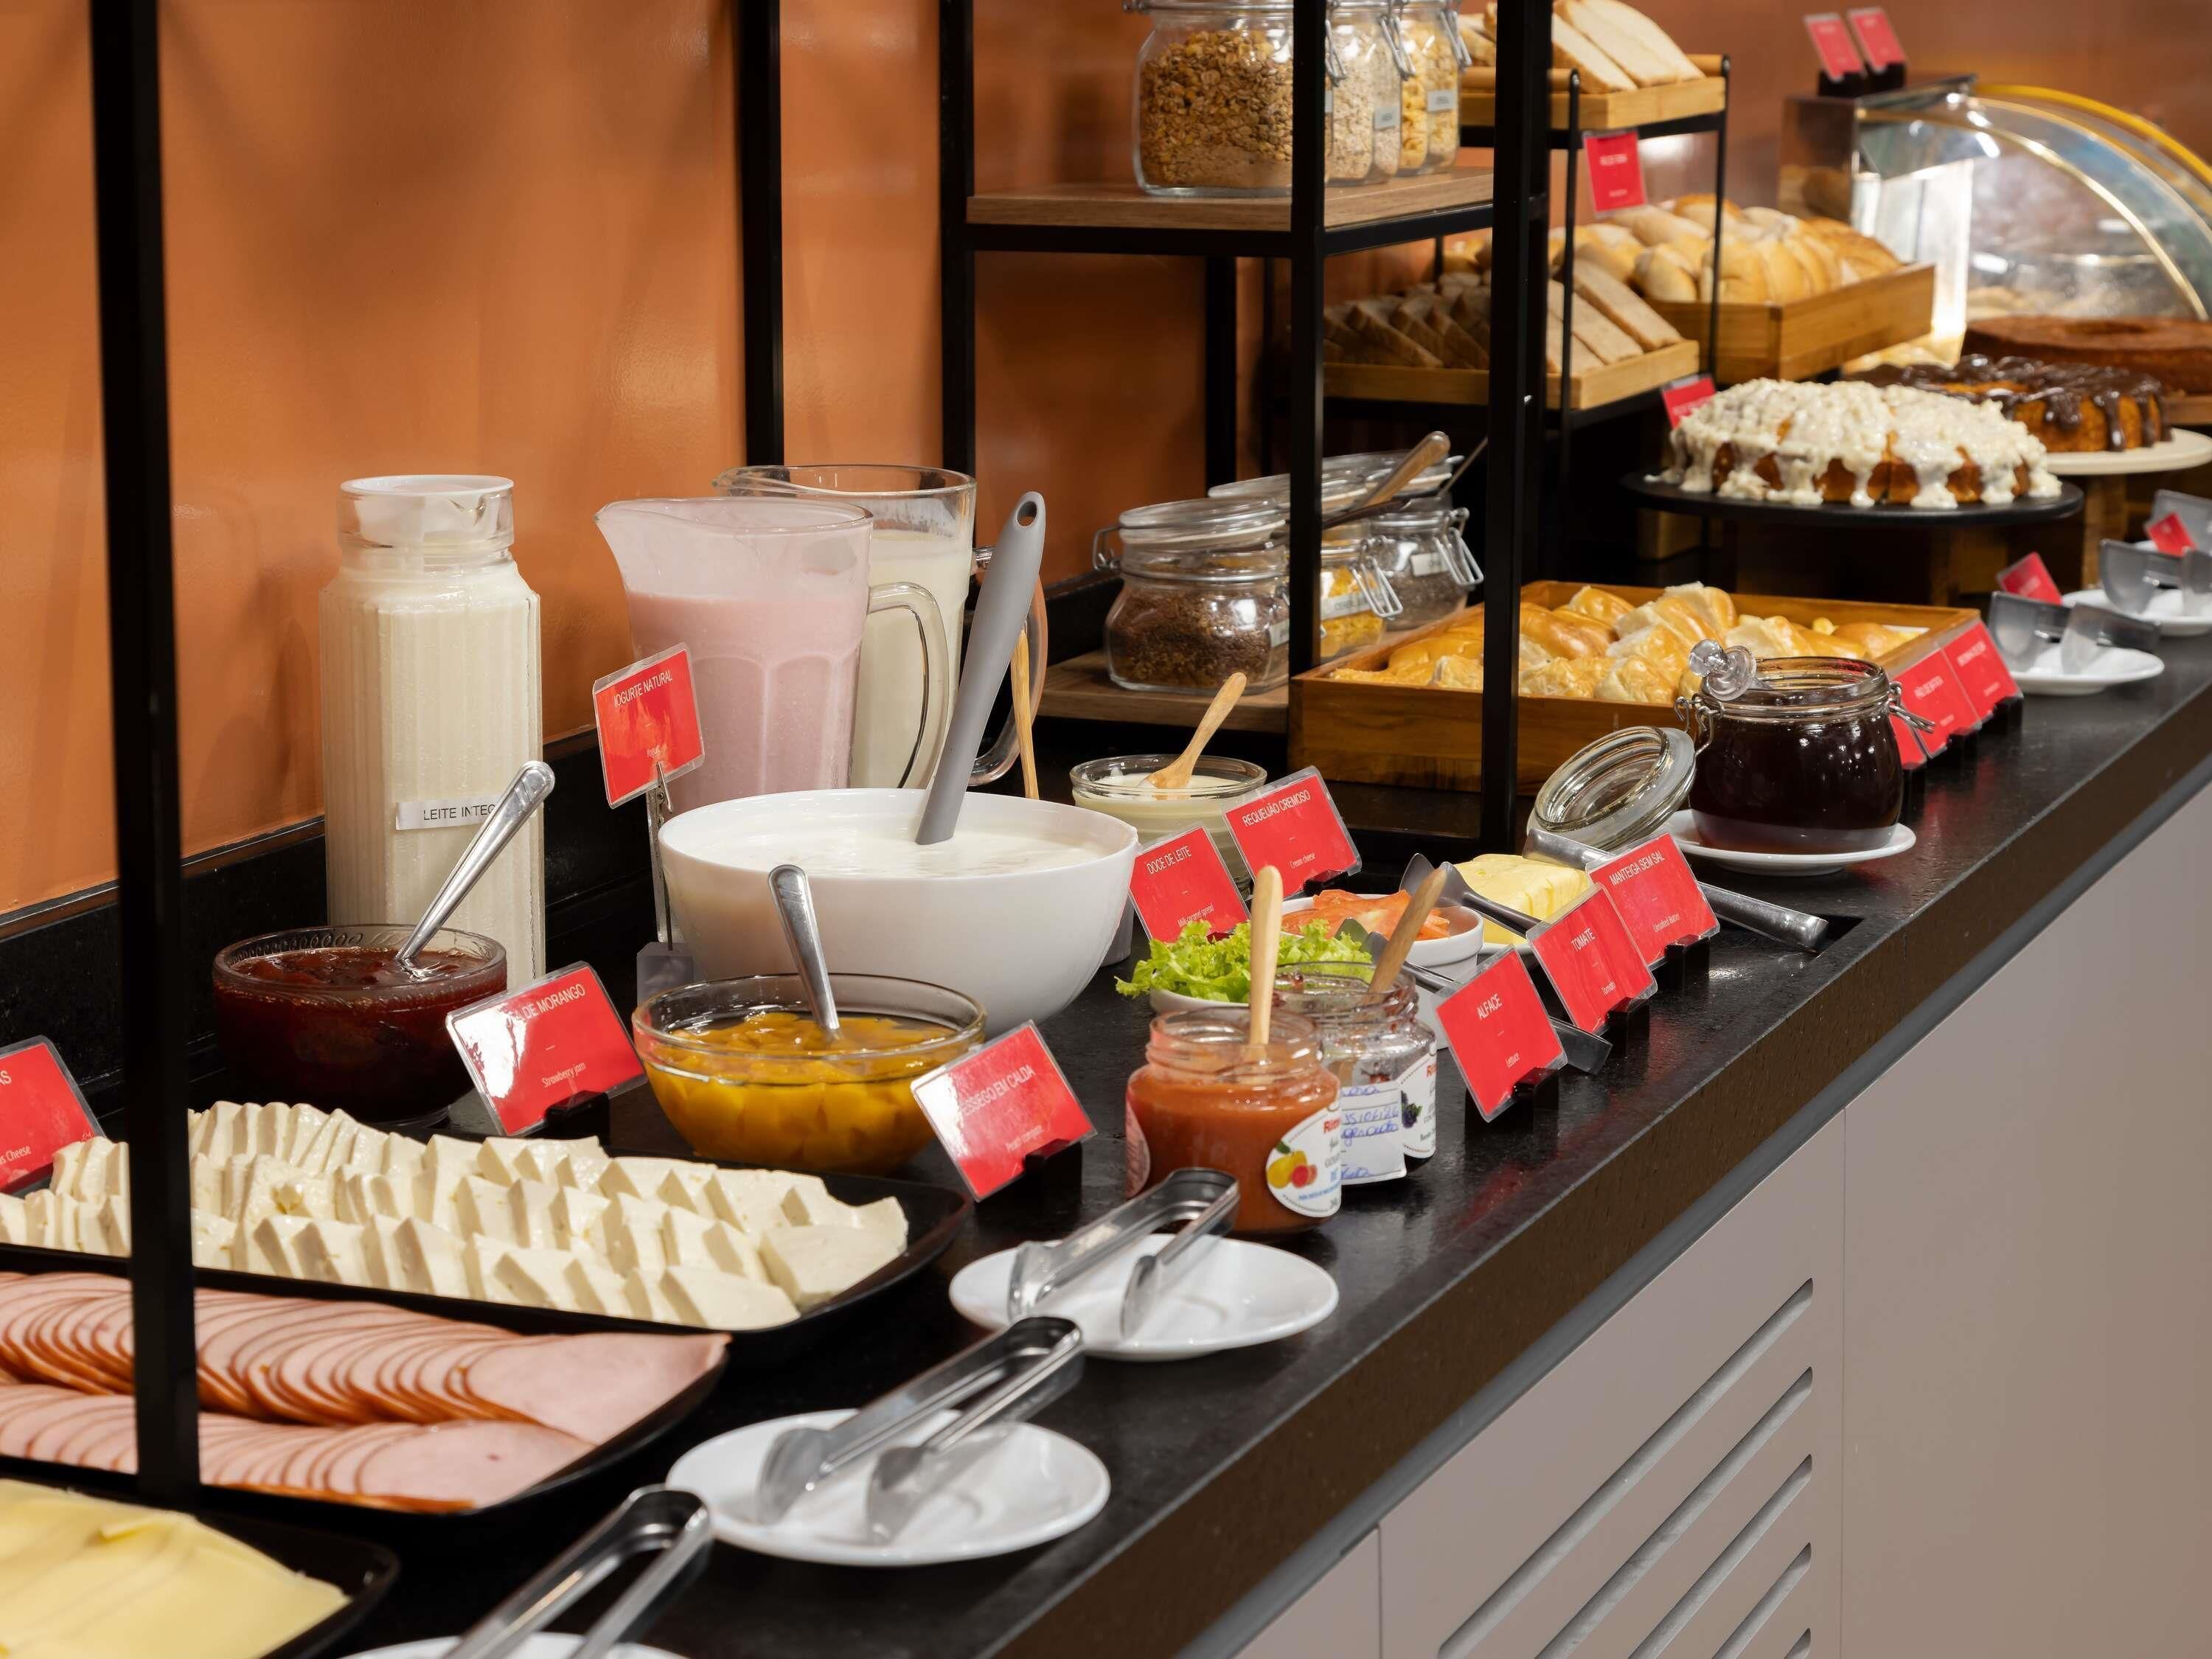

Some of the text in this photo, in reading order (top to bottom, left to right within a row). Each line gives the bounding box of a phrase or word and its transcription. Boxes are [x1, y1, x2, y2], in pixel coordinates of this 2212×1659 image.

[613, 669, 673, 708] IOGURTE NATURAL
[423, 807, 456, 821] LEITE
[1242, 790, 1311, 827] REQUEIJÃO CREMOSO
[1147, 845, 1192, 874] DOCE DE LEITE
[1290, 852, 1316, 869] Cream cheese
[1609, 849, 1666, 886] MANTEIGA SEM SAL
[1201, 902, 1215, 919] spread
[1652, 917, 1669, 933] Unsalted
[1571, 928, 1596, 952] TOMATE
[1601, 981, 1616, 996] Tomato
[521, 1004, 539, 1019] DE
[535, 984, 586, 1014] MORANGO
[1476, 993, 1503, 1020] ALFACE
[1505, 1052, 1520, 1068] Lettuce
[541, 1062, 586, 1088] Strawberry jam
[993, 1079, 1010, 1096] EM
[1006, 1065, 1036, 1088] CALDA
[5, 1145, 32, 1161] Cheese
